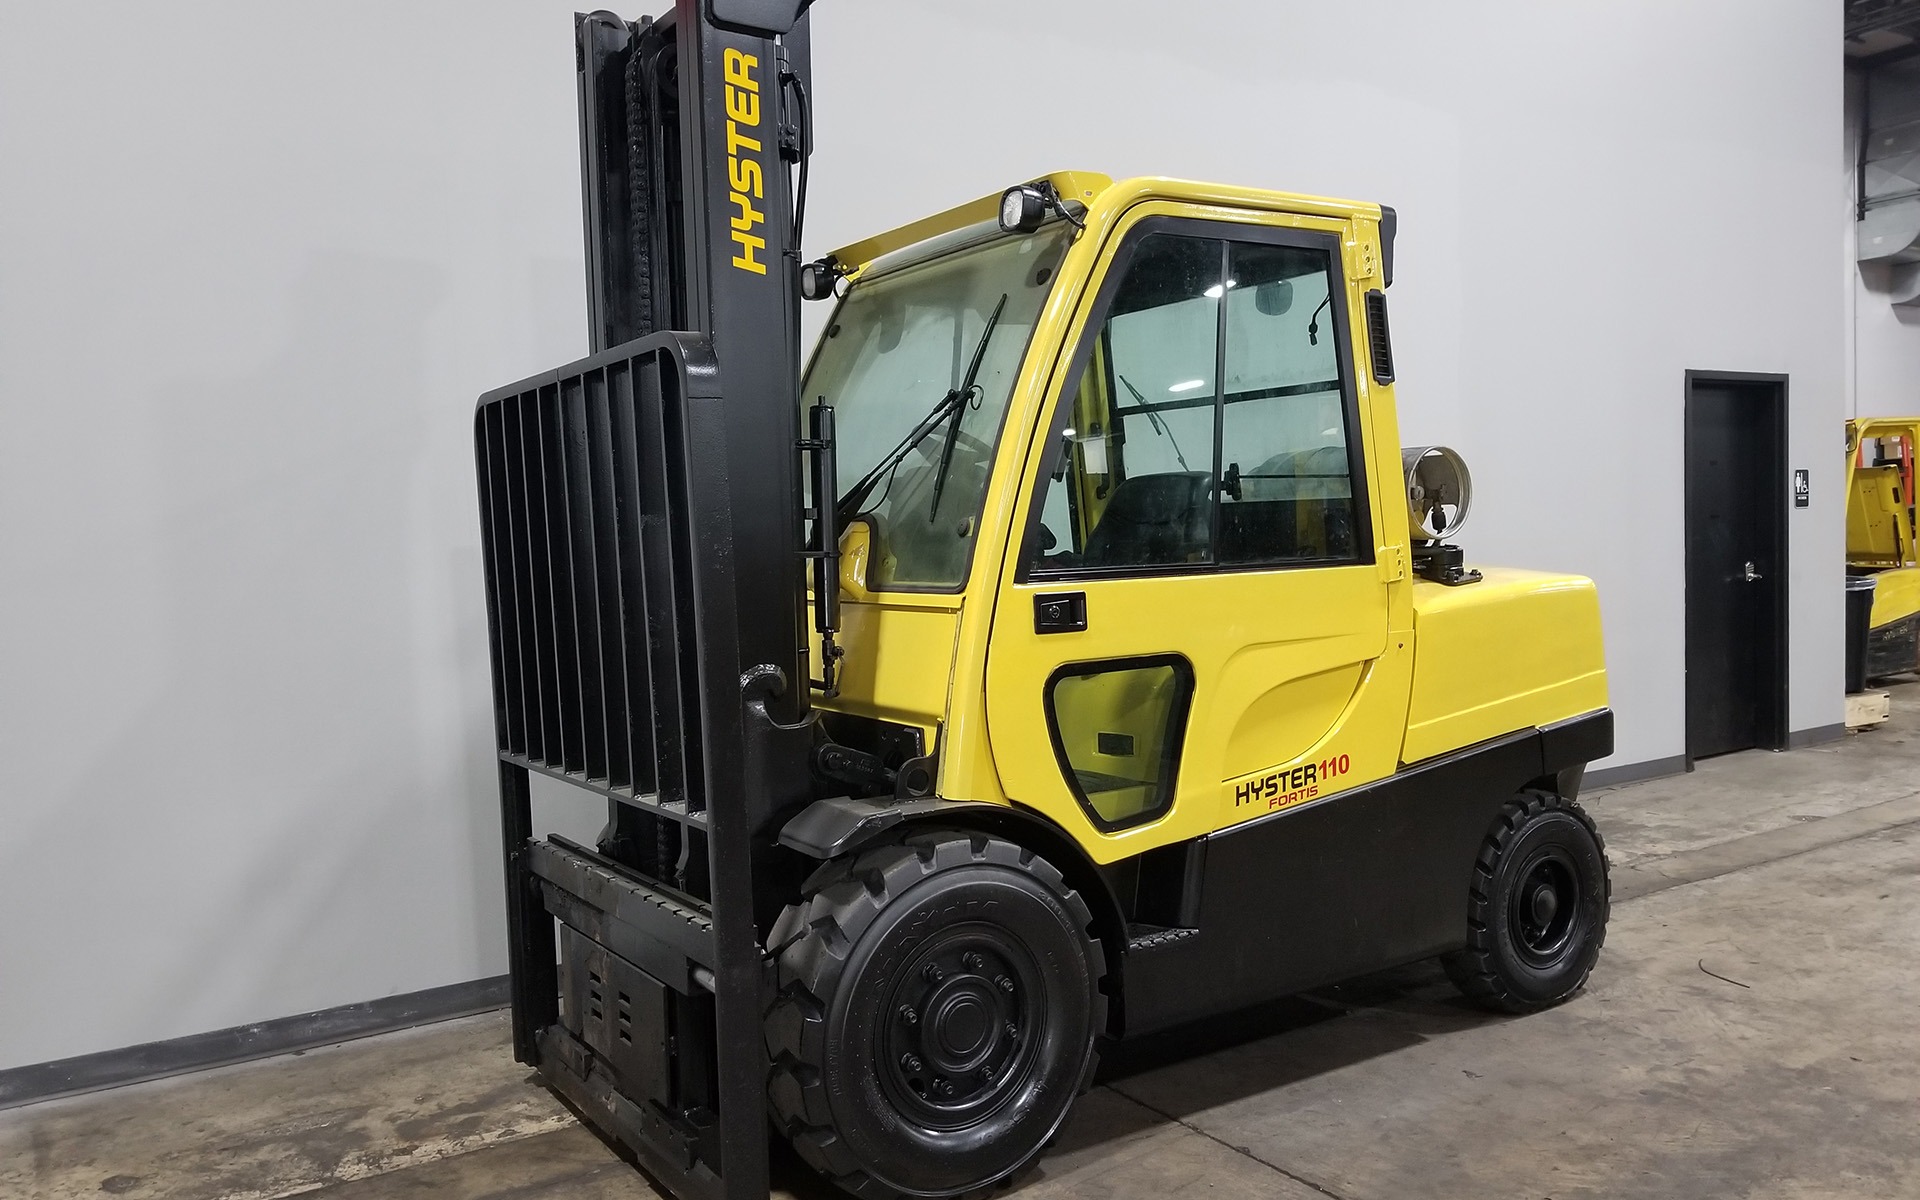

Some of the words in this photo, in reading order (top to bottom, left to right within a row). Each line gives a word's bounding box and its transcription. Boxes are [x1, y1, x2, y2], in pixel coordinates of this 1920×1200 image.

[723, 47, 767, 276] HYSTER
[1235, 763, 1317, 807] HYSTER
[1318, 753, 1350, 780] 110
[1269, 785, 1318, 809] FORTIS
